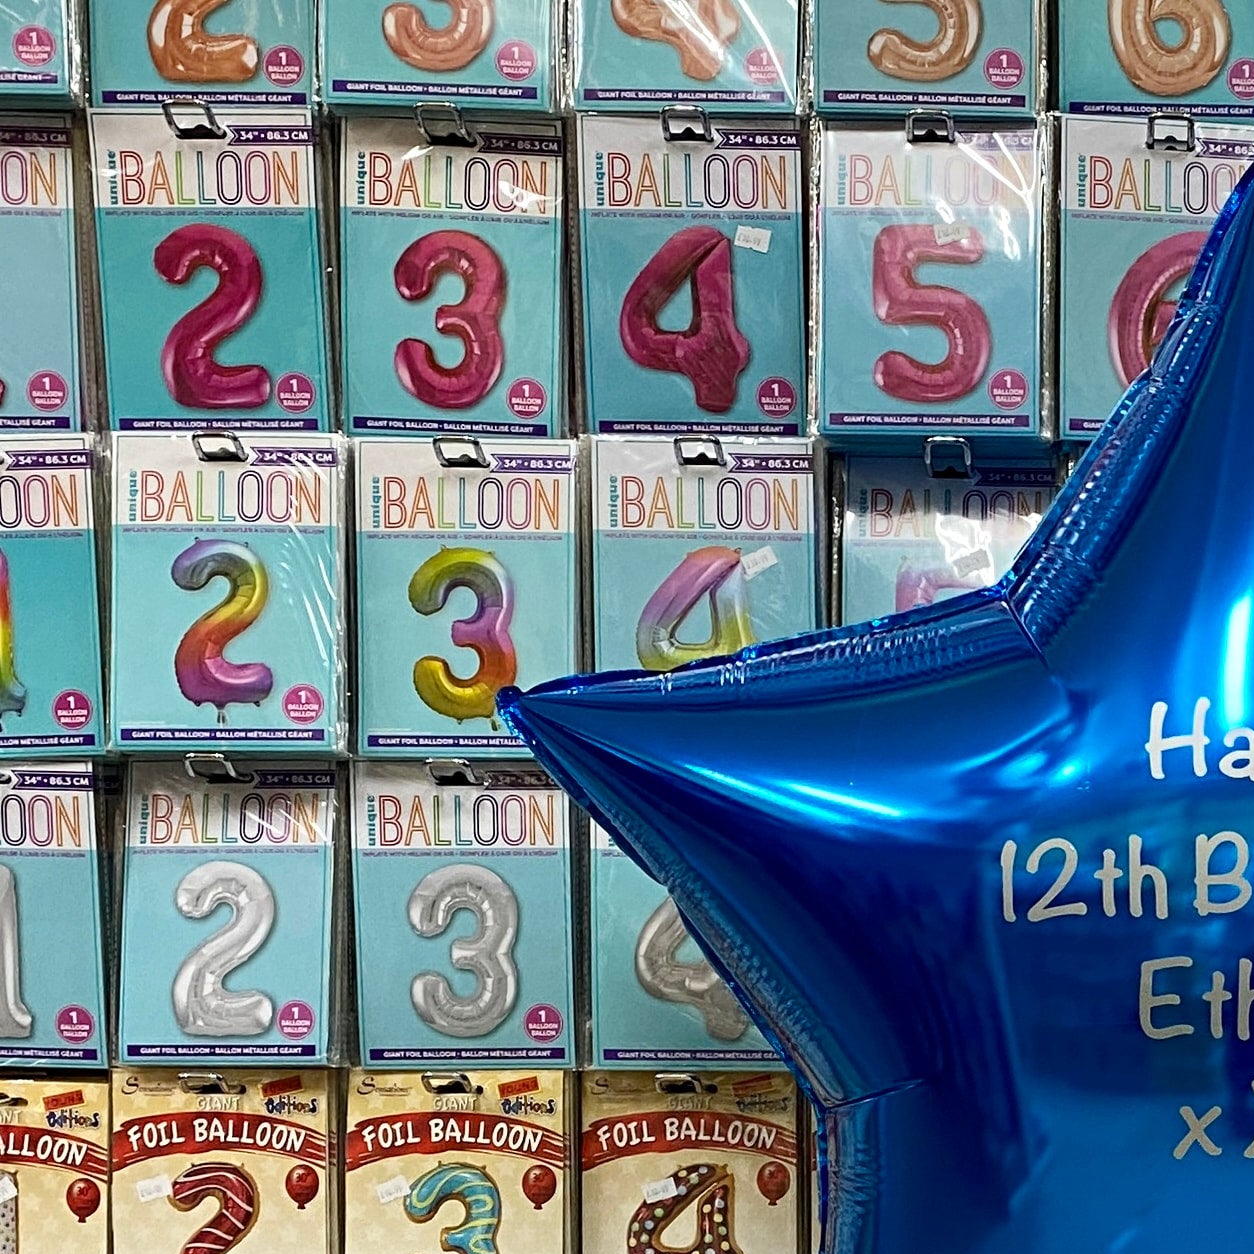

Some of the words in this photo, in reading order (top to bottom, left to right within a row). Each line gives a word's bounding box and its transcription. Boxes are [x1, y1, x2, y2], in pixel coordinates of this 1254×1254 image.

[346, 83, 368, 91] GIANT
[388, 84, 423, 92] BALLOON
[266, 131, 289, 141] 86.3
[291, 131, 309, 141] CM
[755, 134, 779, 145] 86.3
[780, 135, 796, 145] CM
[119, 150, 299, 206] BALLOON
[357, 151, 366, 205] unique
[369, 152, 547, 213] BALLOON
[596, 151, 605, 206] unique
[608, 153, 786, 209] BALLOON
[768, 458, 791, 469] 86.3
[793, 459, 809, 469] CM
[140, 469, 322, 524] BALLOON
[371, 475, 381, 529] unique
[384, 476, 560, 531] BALLOON
[608, 474, 618, 528] unique
[621, 475, 799, 531] BALLOON
[151, 793, 320, 846] BALLOON
[367, 793, 376, 846] unique
[379, 794, 555, 846] BALLOON
[1000, 834, 1169, 922] 12th
[196, 1096, 241, 1111] GIANT
[128, 1119, 185, 1152] FOIL
[194, 1117, 305, 1152] BALLOON
[362, 1118, 421, 1151] FOIL
[429, 1117, 543, 1153] BALLOON
[597, 1118, 656, 1152] FOIL
[664, 1117, 777, 1150] BALLOON
